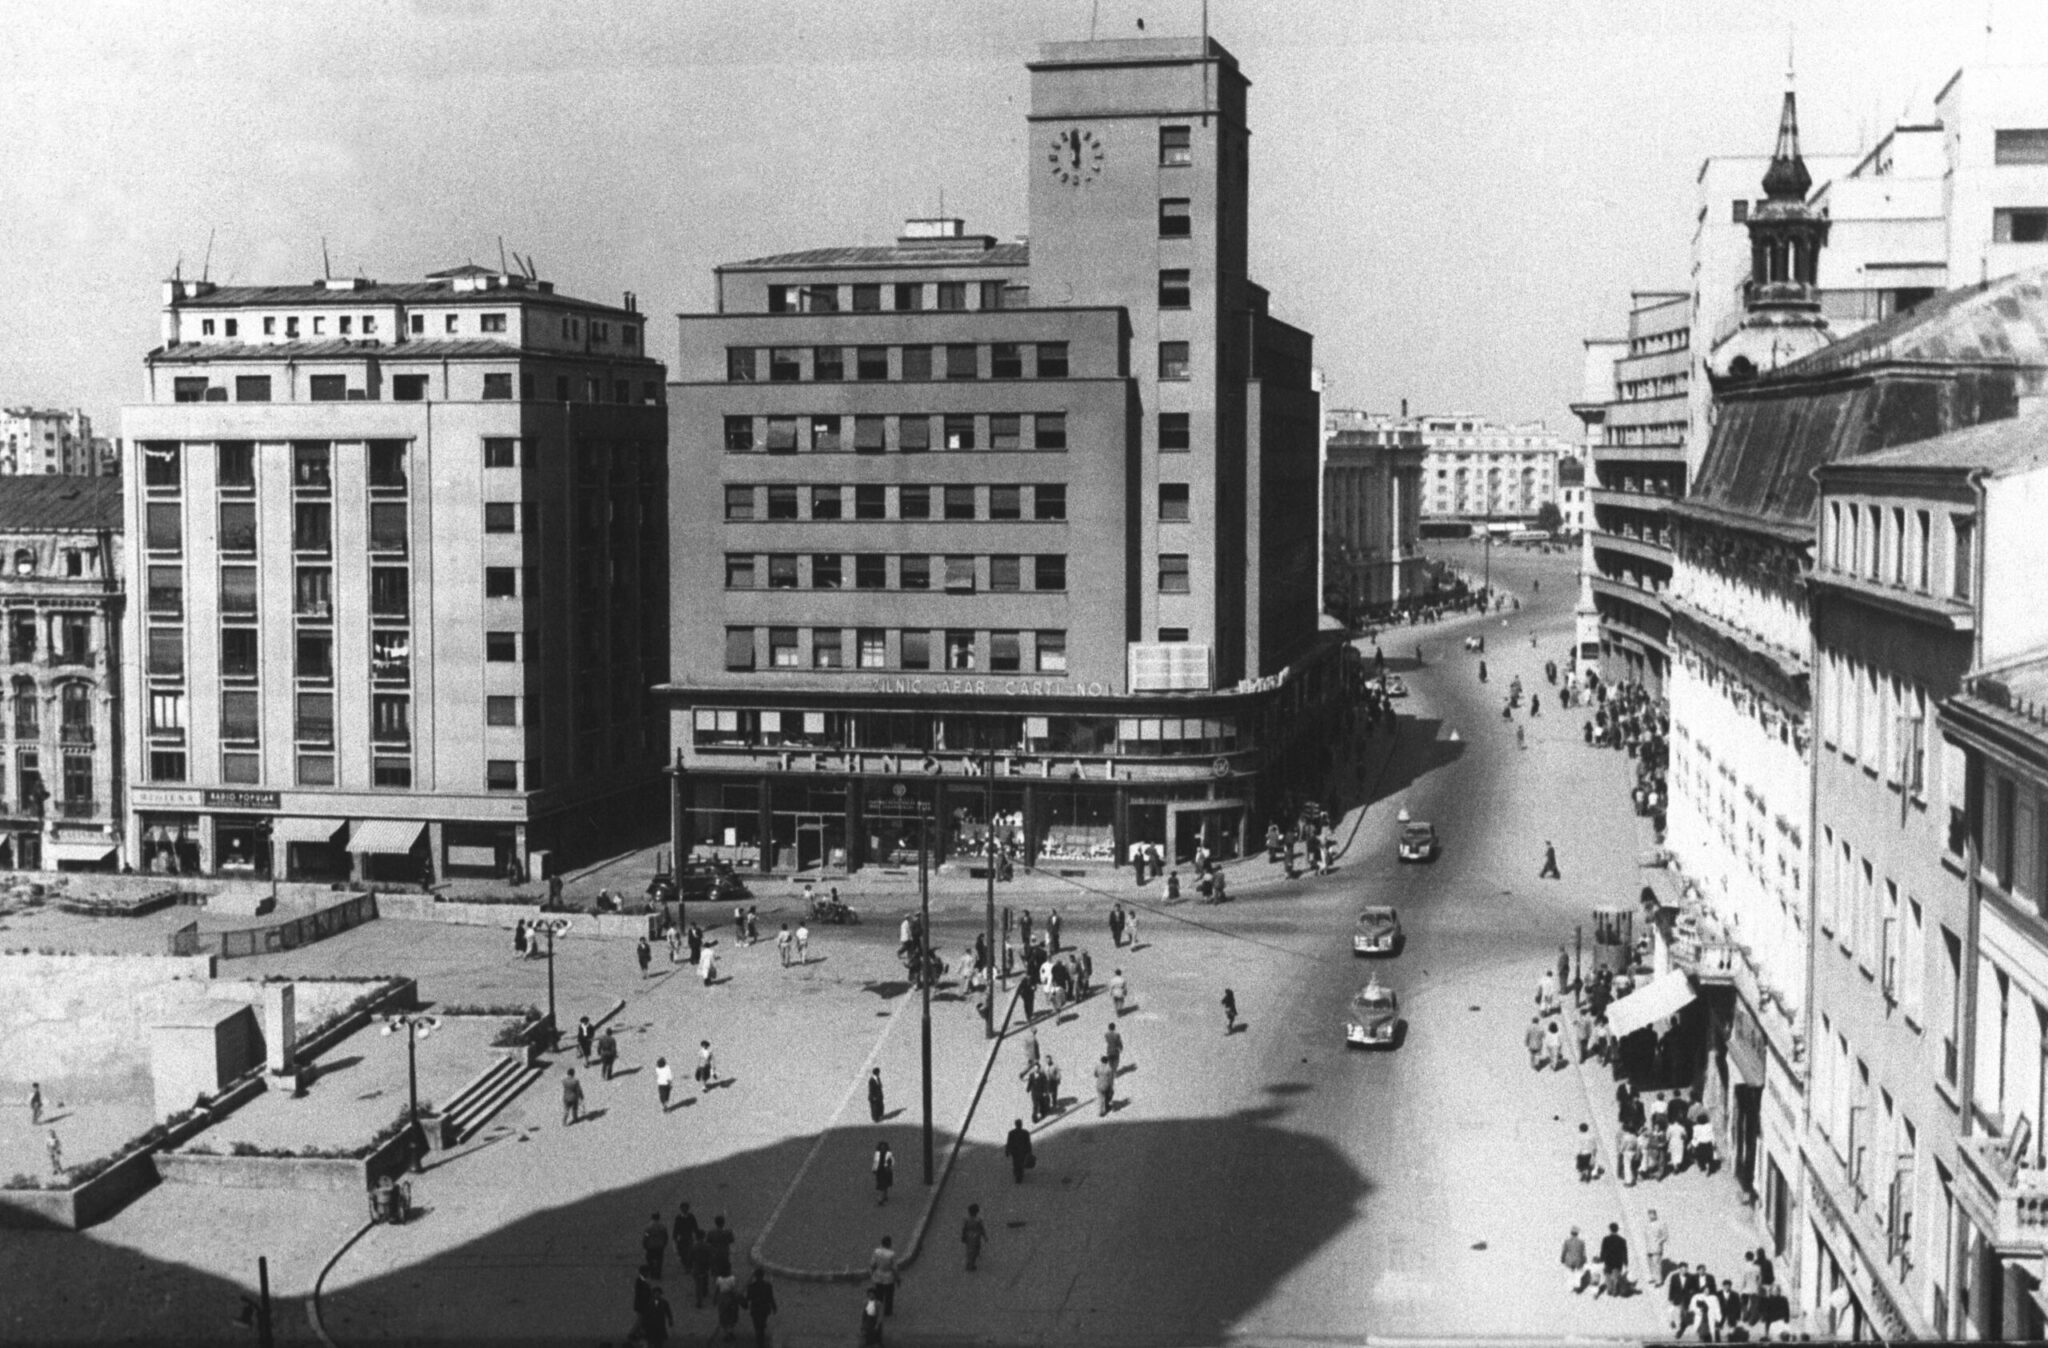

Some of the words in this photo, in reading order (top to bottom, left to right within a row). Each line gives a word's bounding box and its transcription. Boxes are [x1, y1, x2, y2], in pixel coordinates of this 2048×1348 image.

[941, 680, 985, 695] APAR
[777, 752, 1119, 781] TEHNOMETAL
[210, 791, 236, 801] RADIO
[239, 793, 273, 803] POPULAR
